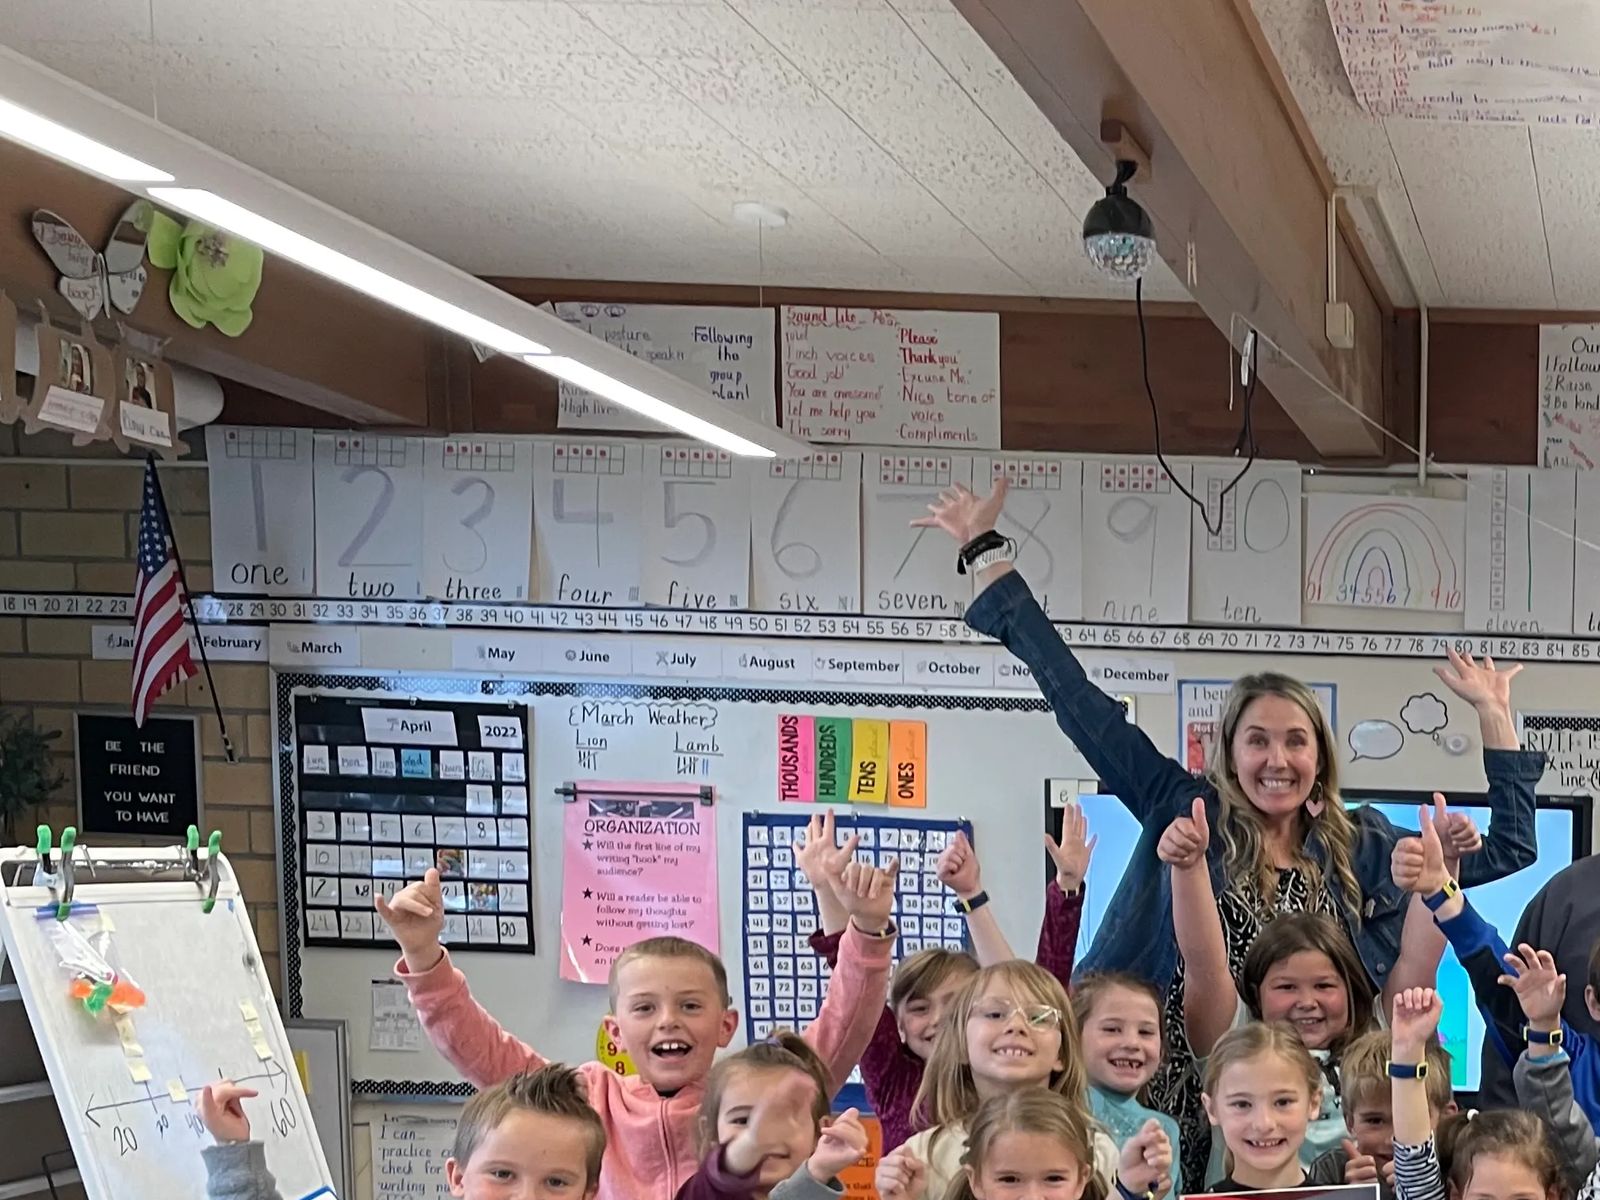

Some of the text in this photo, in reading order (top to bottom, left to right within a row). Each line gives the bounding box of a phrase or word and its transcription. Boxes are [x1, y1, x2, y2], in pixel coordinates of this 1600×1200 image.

[693, 326, 753, 348] Following
[718, 347, 739, 361] the
[710, 370, 742, 385] group
[231, 563, 289, 586] one
[349, 574, 395, 597] two
[446, 575, 502, 600] three
[557, 574, 613, 606] four
[667, 580, 718, 609] five
[780, 591, 820, 611] six
[878, 590, 948, 611] seven
[1103, 599, 1161, 623] nine
[1222, 596, 1262, 624] ten
[550, 611, 932, 637] 42 50 52 55 57
[1485, 616, 1544, 633] eleven
[203, 636, 261, 653] February
[302, 641, 342, 655] March
[1197, 631, 1424, 652] 69 72 78
[488, 647, 516, 663] May
[579, 650, 610, 665] June
[671, 652, 697, 669] July
[749, 655, 795, 672] August
[828, 659, 899, 674] September
[928, 662, 980, 676] October
[1103, 668, 1169, 682] December
[401, 720, 517, 737] April 2022
[105, 741, 165, 754] BE THE
[576, 730, 719, 752] Lion Lamb
[782, 716, 798, 801] THOUSANDS
[819, 725, 836, 796] HUNDREDS
[1561, 759, 1573, 769] in
[110, 764, 160, 776] FRIEND
[857, 761, 876, 794] TENS
[898, 762, 914, 799] ONES
[104, 791, 175, 804] YOU WANT
[116, 811, 169, 823] TO HAVE
[316, 819, 487, 838] 3 8
[585, 819, 700, 836] ORGANIZATION
[597, 840, 683, 852] Will the first line of
[597, 854, 630, 865] writing
[597, 867, 643, 876] audience?
[311, 879, 326, 898] 17
[597, 892, 655, 902] Will reader
[596, 919, 633, 928] without
[776, 918, 789, 928] 42
[777, 961, 790, 971] 62
[800, 983, 813, 993] 73
[113, 1126, 137, 1156] 20
[394, 1129, 415, 1139] can
[382, 1143, 432, 1159] practice
[382, 1161, 441, 1174] check for
[381, 1179, 425, 1193] writing
